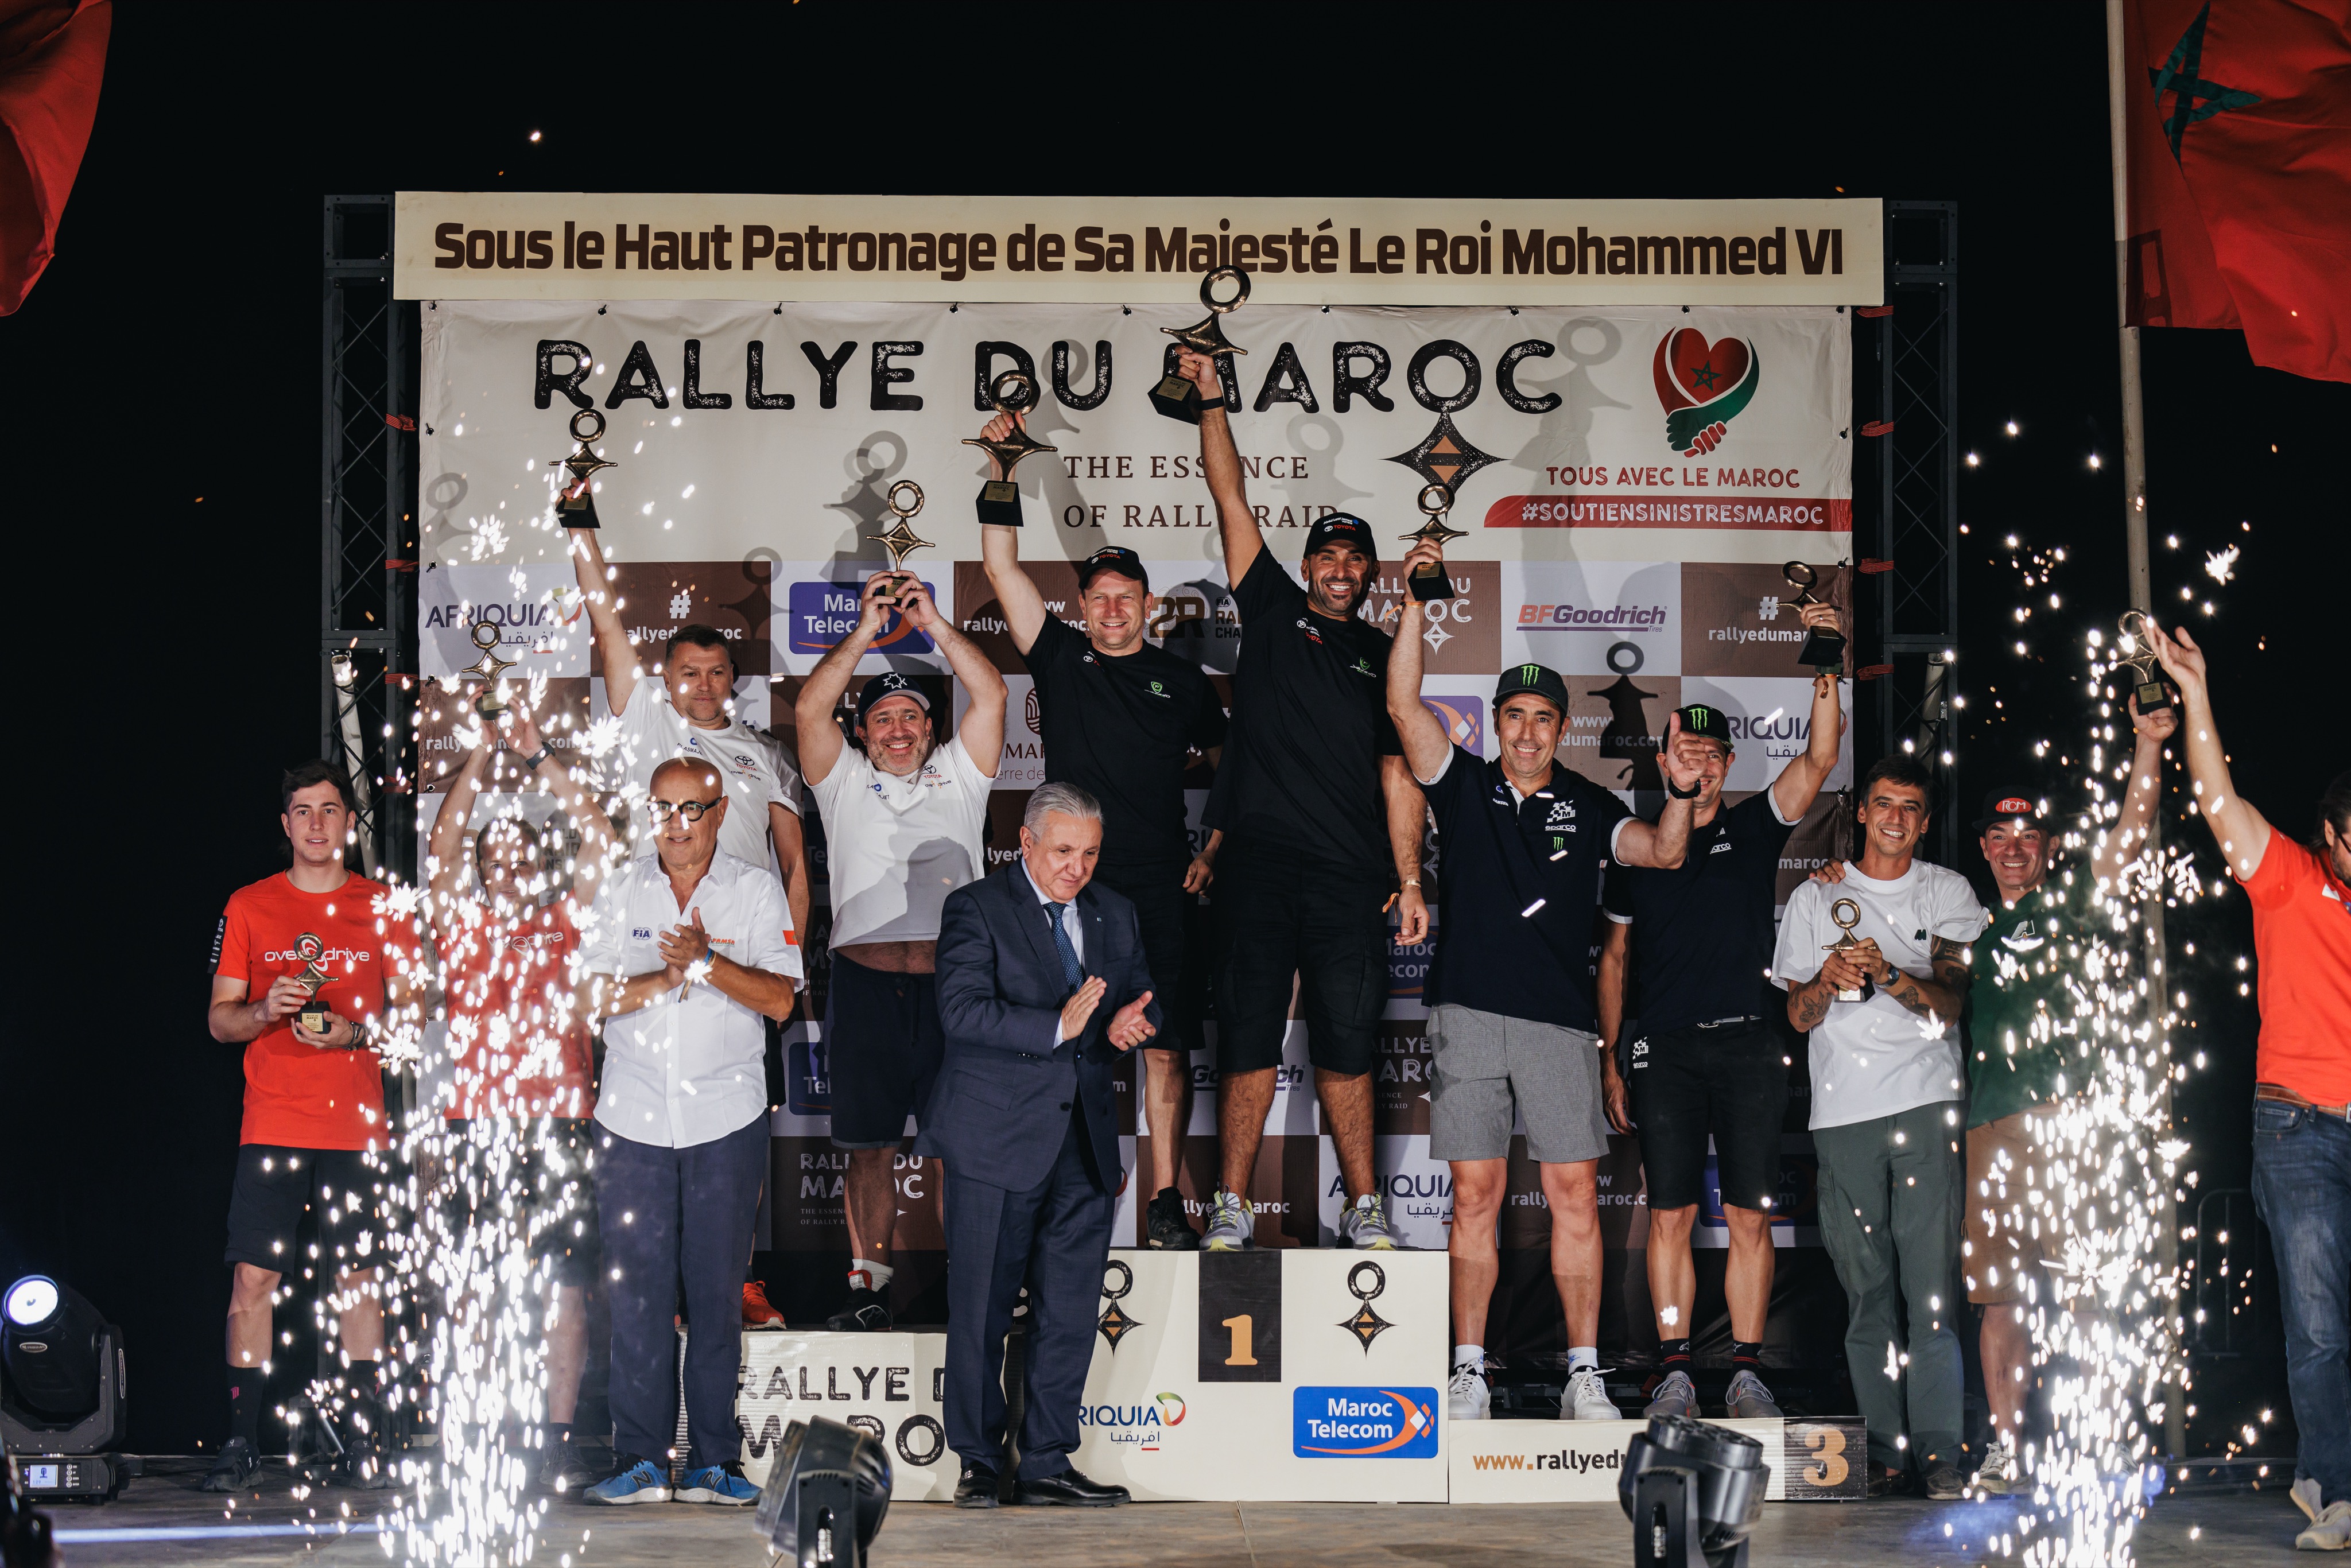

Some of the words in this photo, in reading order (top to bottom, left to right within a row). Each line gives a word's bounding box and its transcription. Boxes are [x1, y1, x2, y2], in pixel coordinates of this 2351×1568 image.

[434, 222, 553, 269] Sous
[564, 221, 605, 270] le
[615, 224, 732, 270] Haut
[742, 224, 997, 281] Patronage
[1006, 223, 1065, 271] de
[1074, 226, 1134, 273] Sa
[1145, 218, 1339, 281] Majesté
[1349, 227, 1406, 274] Le
[1416, 219, 1492, 275] Roi
[1503, 227, 1787, 275] Mohammed
[1794, 228, 1844, 275] VI
[534, 339, 924, 410] RALLYE
[974, 339, 1112, 412] DU
[1064, 456, 1134, 478] THE
[1150, 456, 1309, 479] ESSNCE
[1546, 466, 1608, 486] TOUS
[1616, 467, 1675, 486] AVEC
[1683, 468, 1709, 486] LE
[1717, 468, 1801, 488] MAROC
[1064, 505, 1107, 527] OF
[1123, 505, 1212, 527] RALL
[1522, 503, 1824, 524] #SOUTIENSINISTRESMAROC
[1359, 599, 1472, 623] MAOC
[624, 626, 742, 643] allyedroc
[804, 616, 889, 633] Telecm
[1709, 627, 1807, 644] rallyedumar
[1725, 716, 1811, 740] RIQUI
[735, 763, 757, 771] TOYOTA
[1492, 798, 1509, 806] SAMSUN
[1710, 843, 1731, 852] arco
[265, 950, 301, 962] ove
[323, 948, 370, 962] drive
[1386, 941, 1437, 956] aroc
[1372, 1038, 1431, 1053] ALLYE
[801, 1174, 924, 1198] MAC
[1328, 1174, 1454, 1198] AIQUI
[1222, 1314, 1258, 1366] 1
[735, 1365, 910, 1402] RALLYE
[1078, 1406, 1161, 1426] RIQUIA
[1328, 1398, 1392, 1417] Maroc
[1308, 1420, 1392, 1438] Telecom
[1472, 1449, 1619, 1474] www.rallyed
[1802, 1427, 1849, 1486] 3
